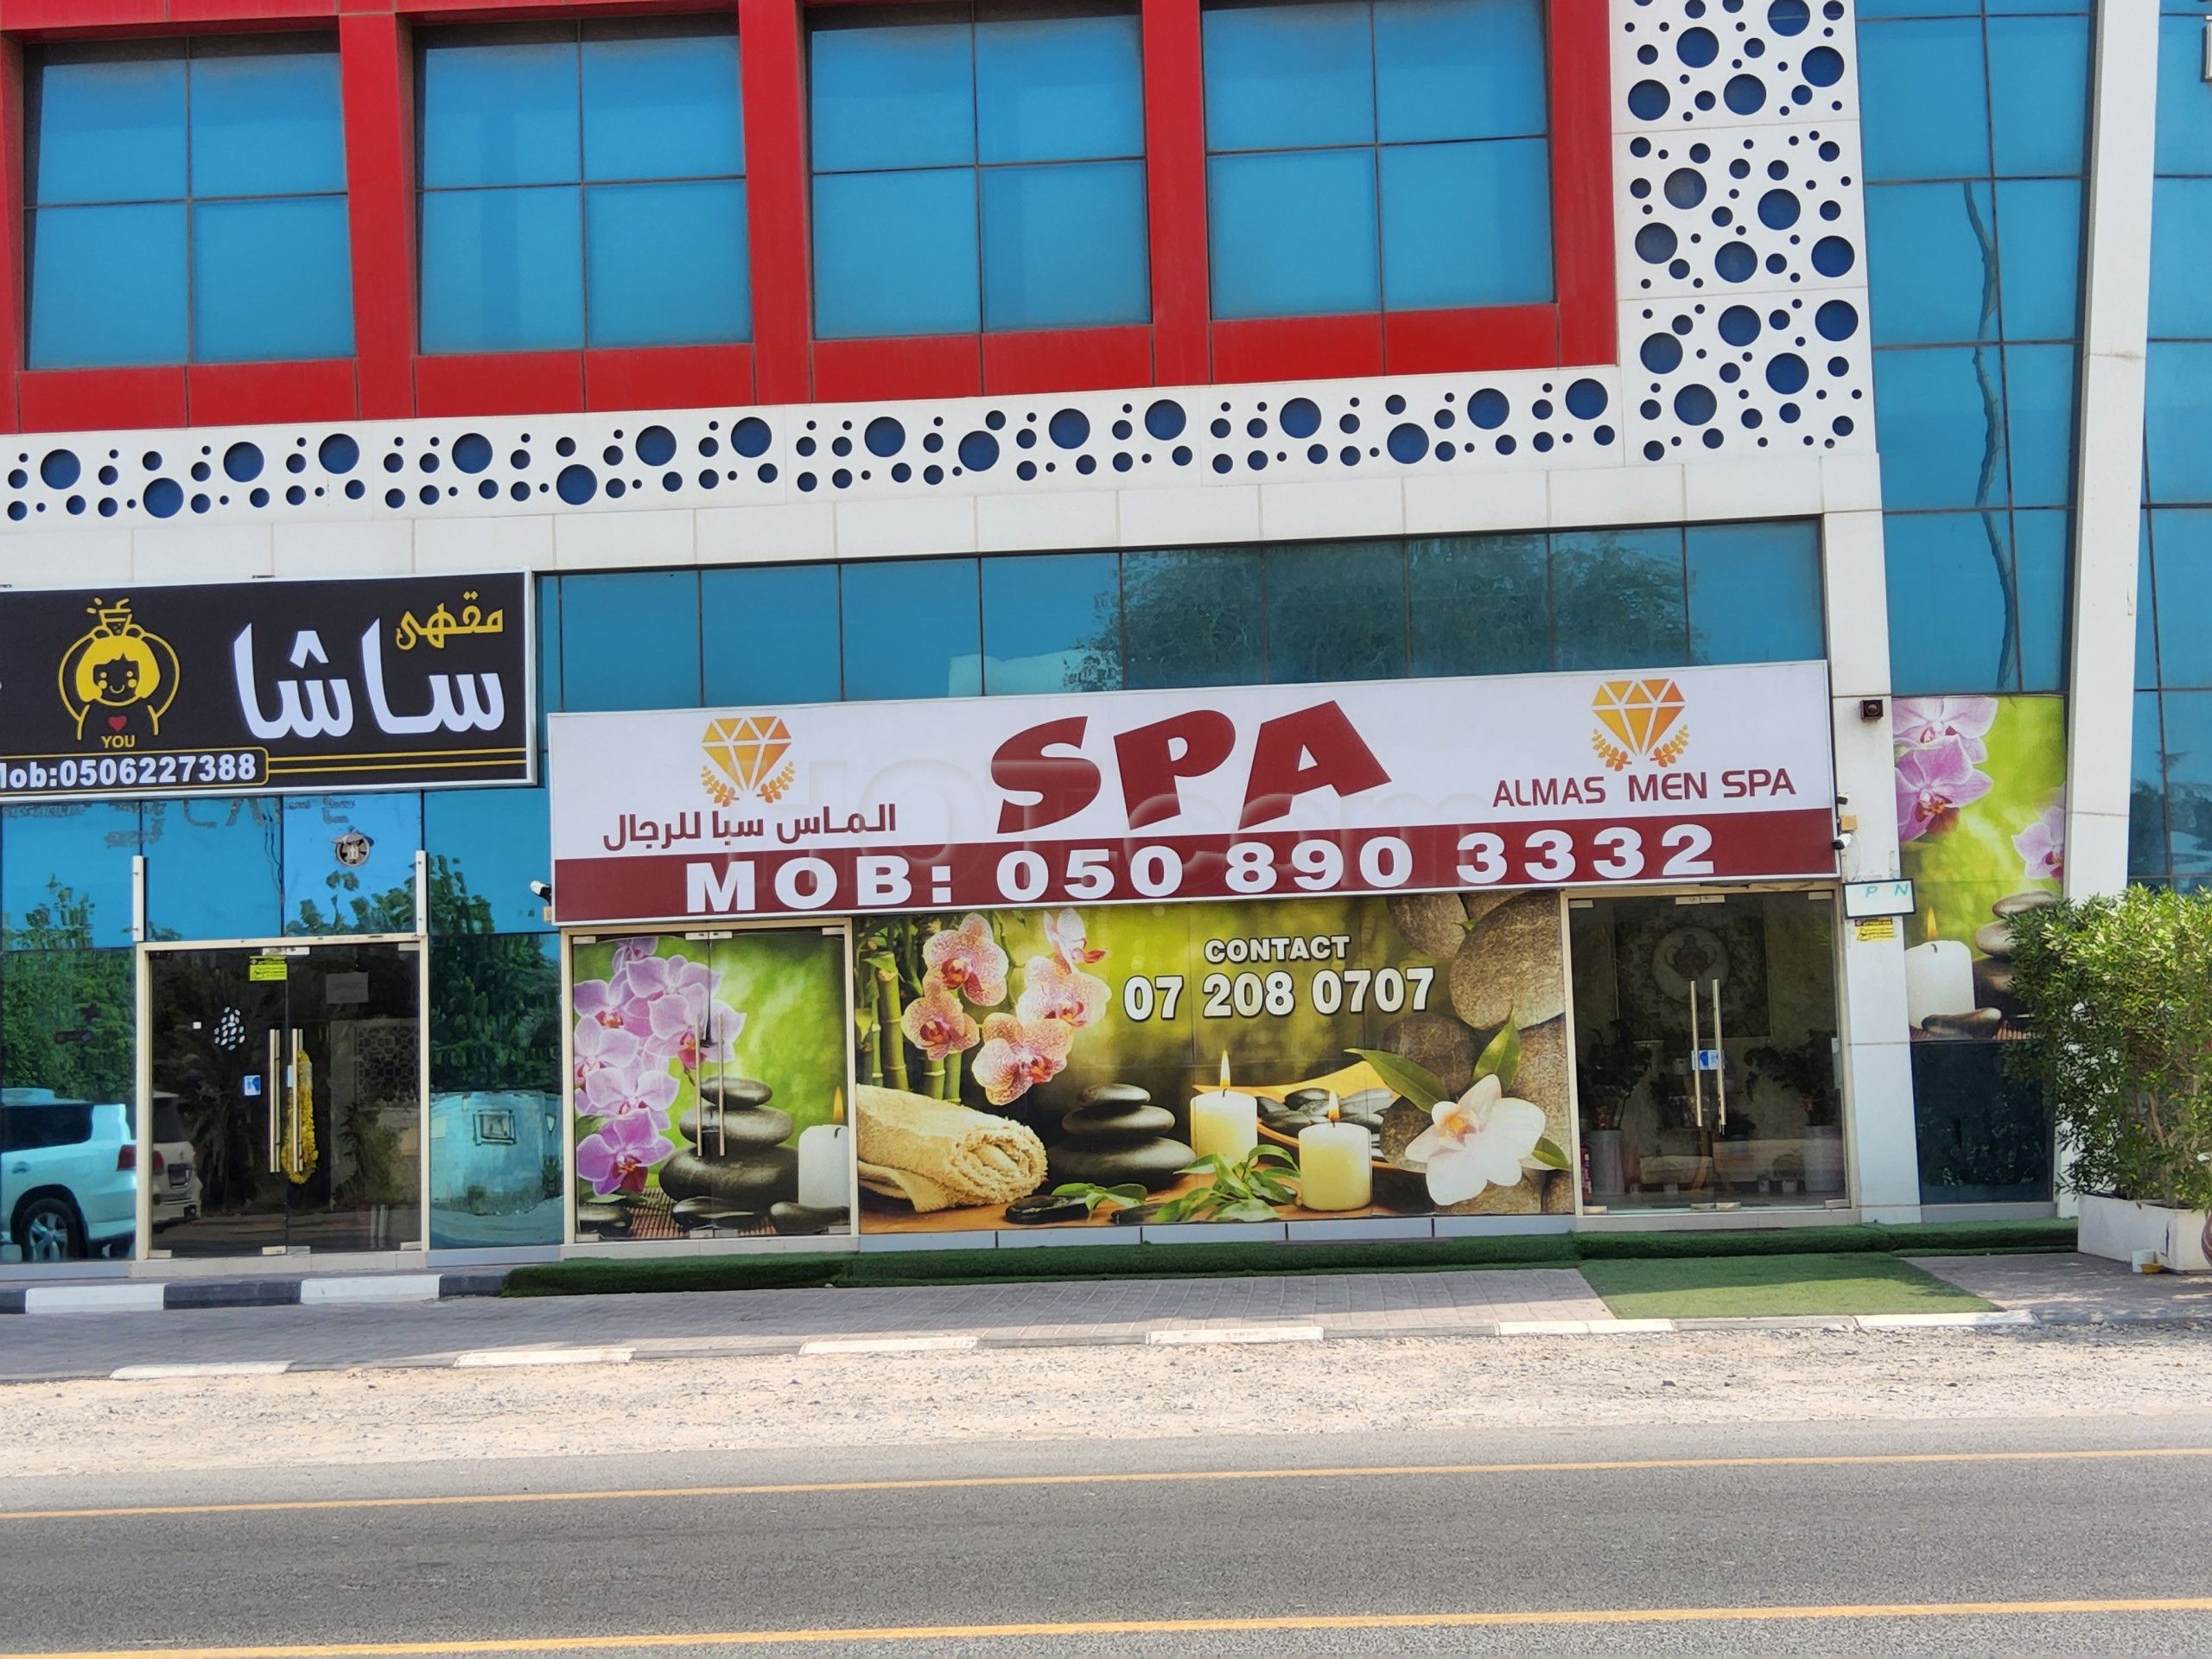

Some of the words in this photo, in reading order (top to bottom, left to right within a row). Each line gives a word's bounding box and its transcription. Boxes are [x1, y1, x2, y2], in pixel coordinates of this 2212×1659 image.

[232, 617, 505, 741] ساشا
[100, 734, 137, 749] YOU
[991, 701, 1392, 835] SPA
[1492, 776, 1606, 807] ALMAS
[1628, 772, 1708, 802] MEN
[1722, 768, 1796, 798] SPA
[603, 811, 702, 851] للرجال
[711, 810, 765, 847] سبا
[776, 804, 897, 844] الماس
[686, 855, 952, 913] MOB:
[996, 845, 1183, 902] 050
[1225, 836, 1413, 893] 890
[1456, 823, 1714, 885] 3332
[1204, 935, 1351, 963] CONTACT
[1123, 975, 1184, 1021] 07
[1202, 970, 1296, 1018] 208
[1311, 967, 1436, 1015] 0707
